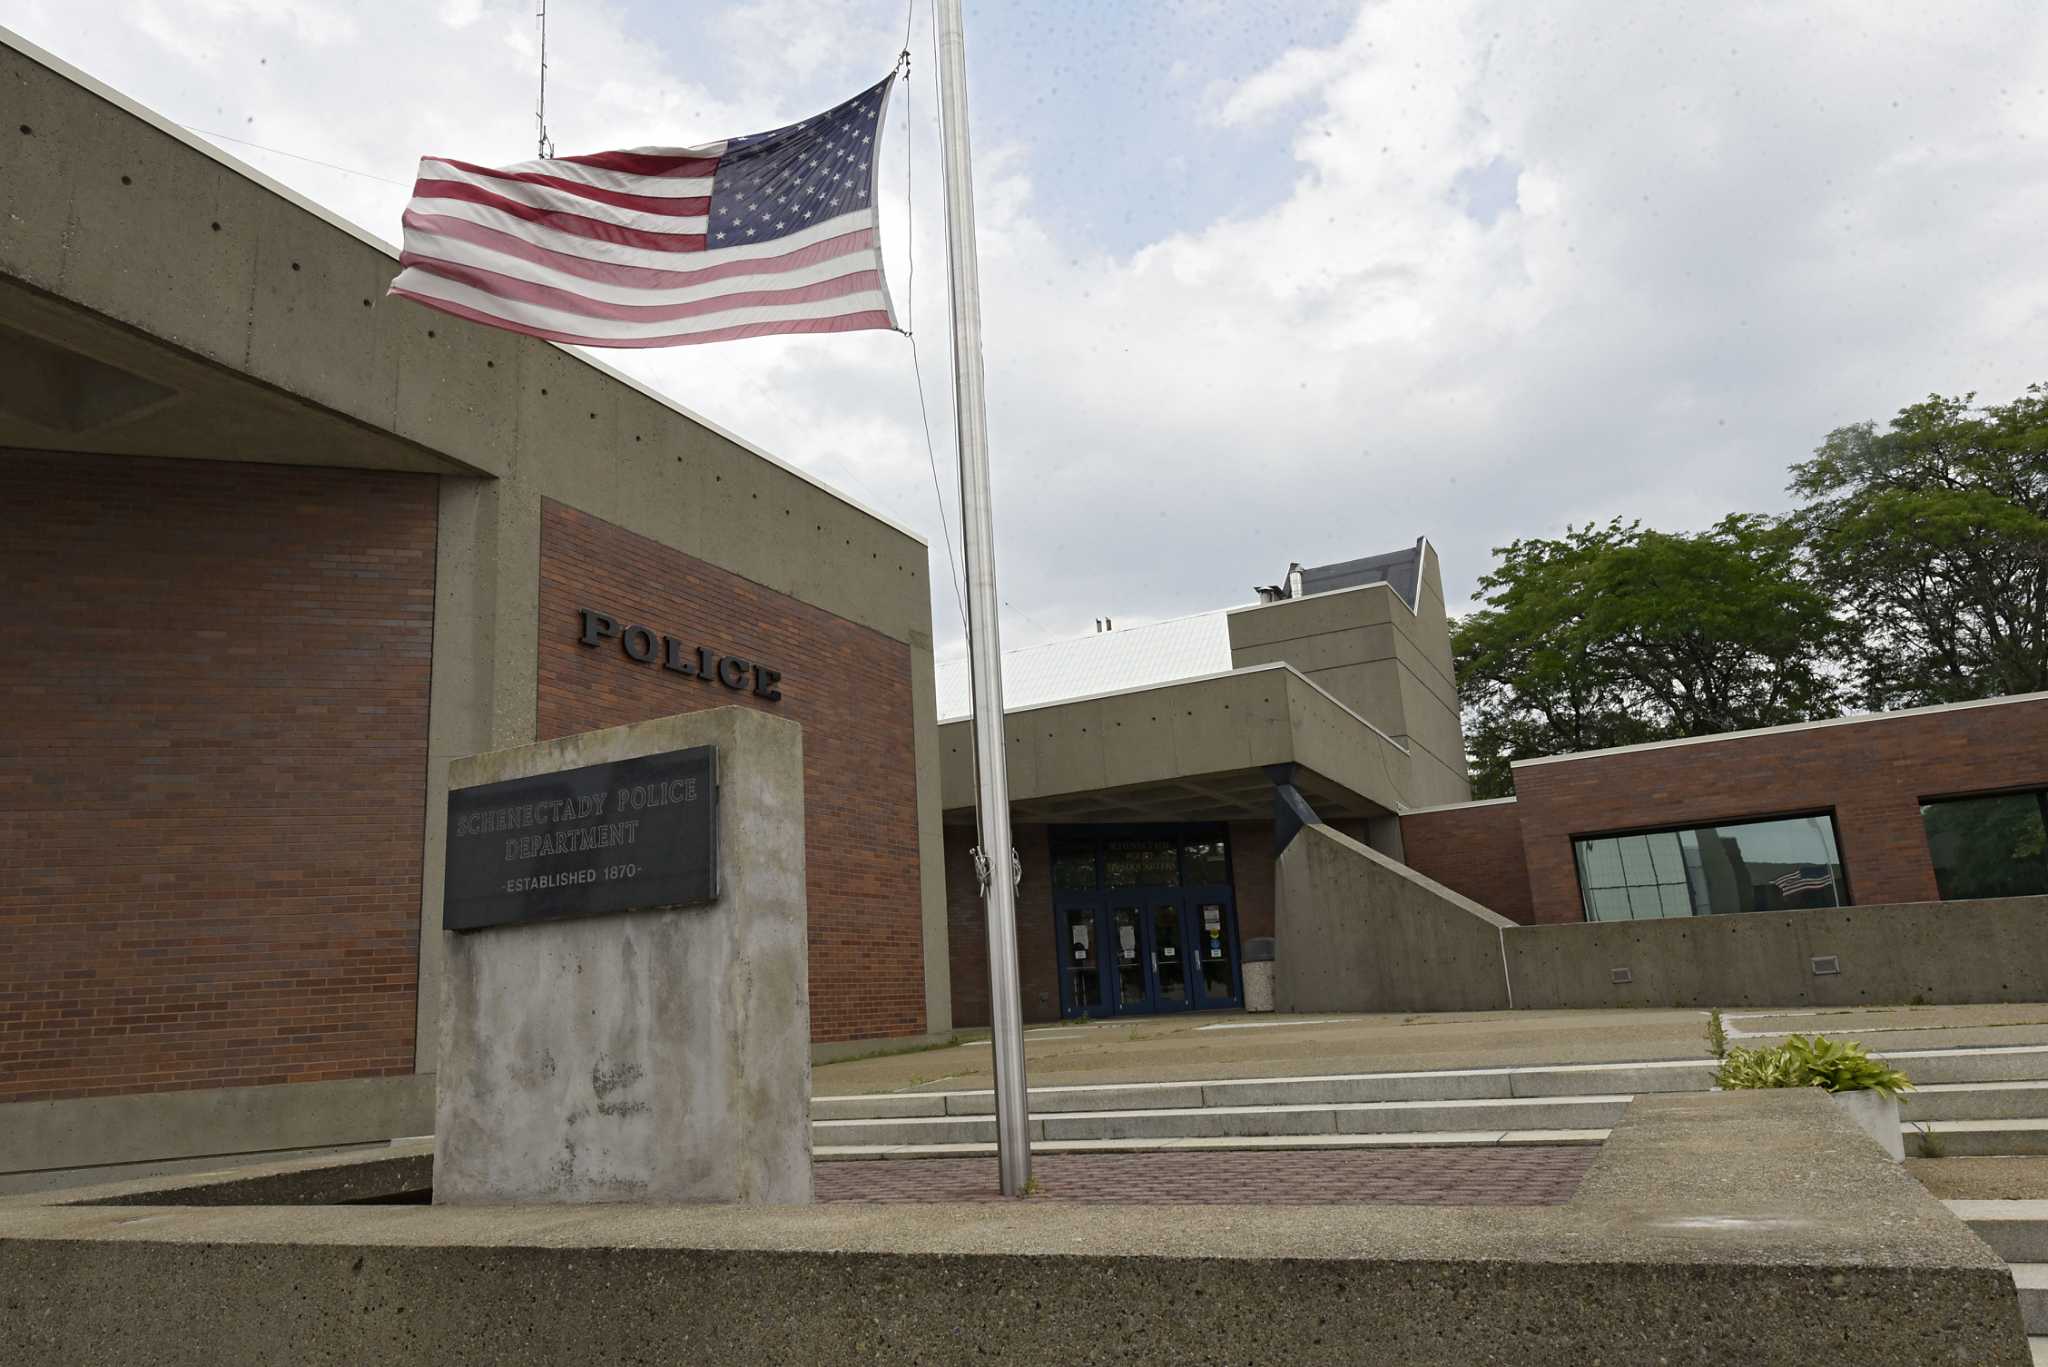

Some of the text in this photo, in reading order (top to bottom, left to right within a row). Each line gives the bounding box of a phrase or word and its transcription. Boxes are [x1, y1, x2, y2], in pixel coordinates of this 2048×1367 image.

[579, 608, 781, 701] POLICE
[456, 777, 698, 837] SCHENECTADY POLICE
[504, 820, 640, 861] DEPARTMENT
